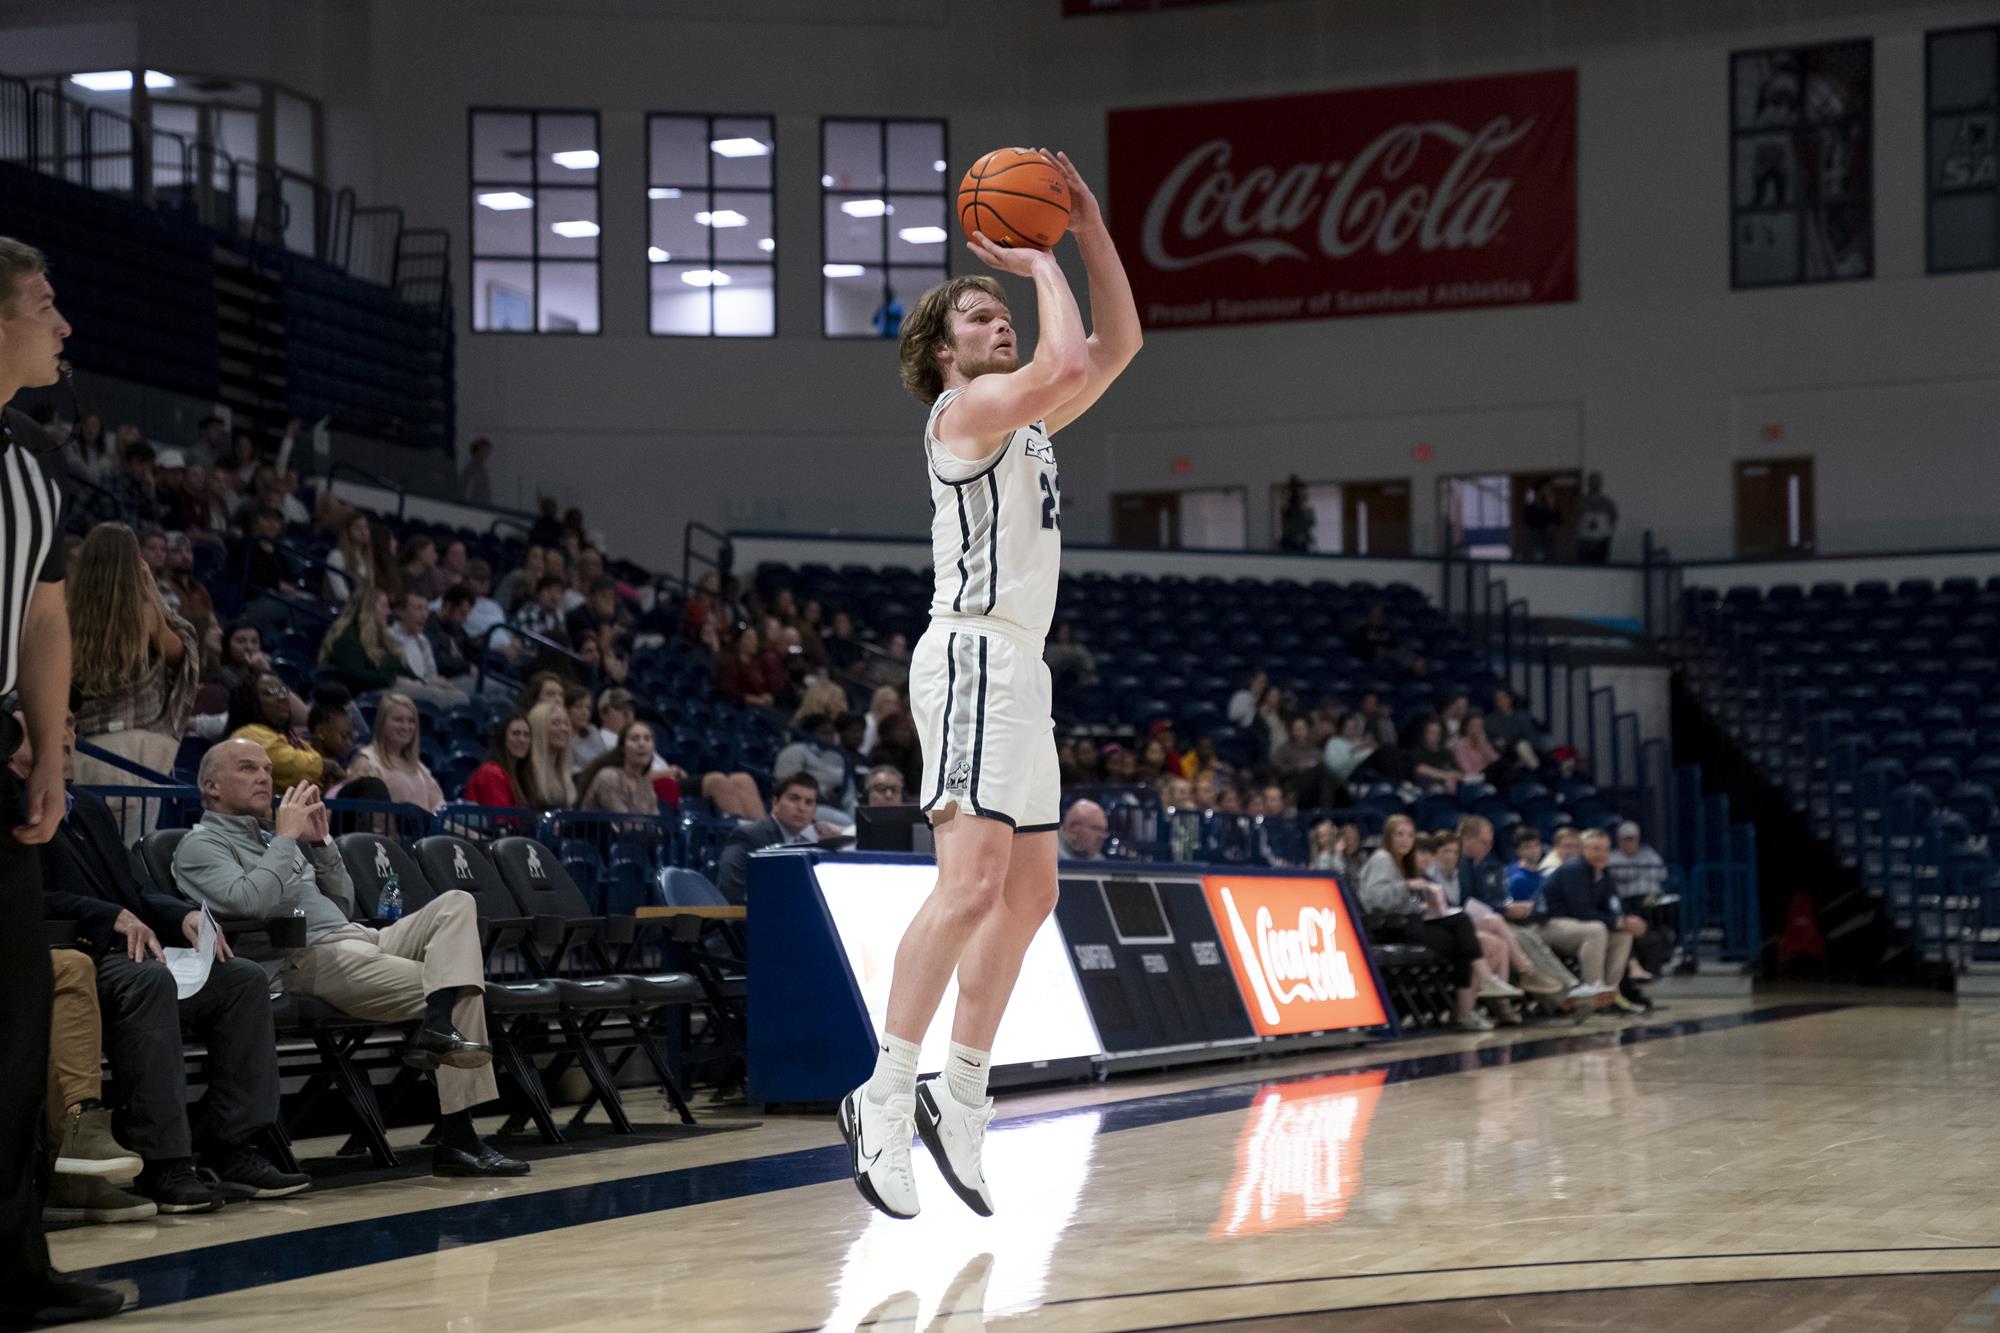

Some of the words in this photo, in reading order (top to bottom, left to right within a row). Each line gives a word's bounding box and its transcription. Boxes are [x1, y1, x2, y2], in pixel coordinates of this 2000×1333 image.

[1142, 115, 1536, 270] Coca-Cola
[1216, 297, 1302, 322] Sponsor
[1308, 292, 1330, 314] of
